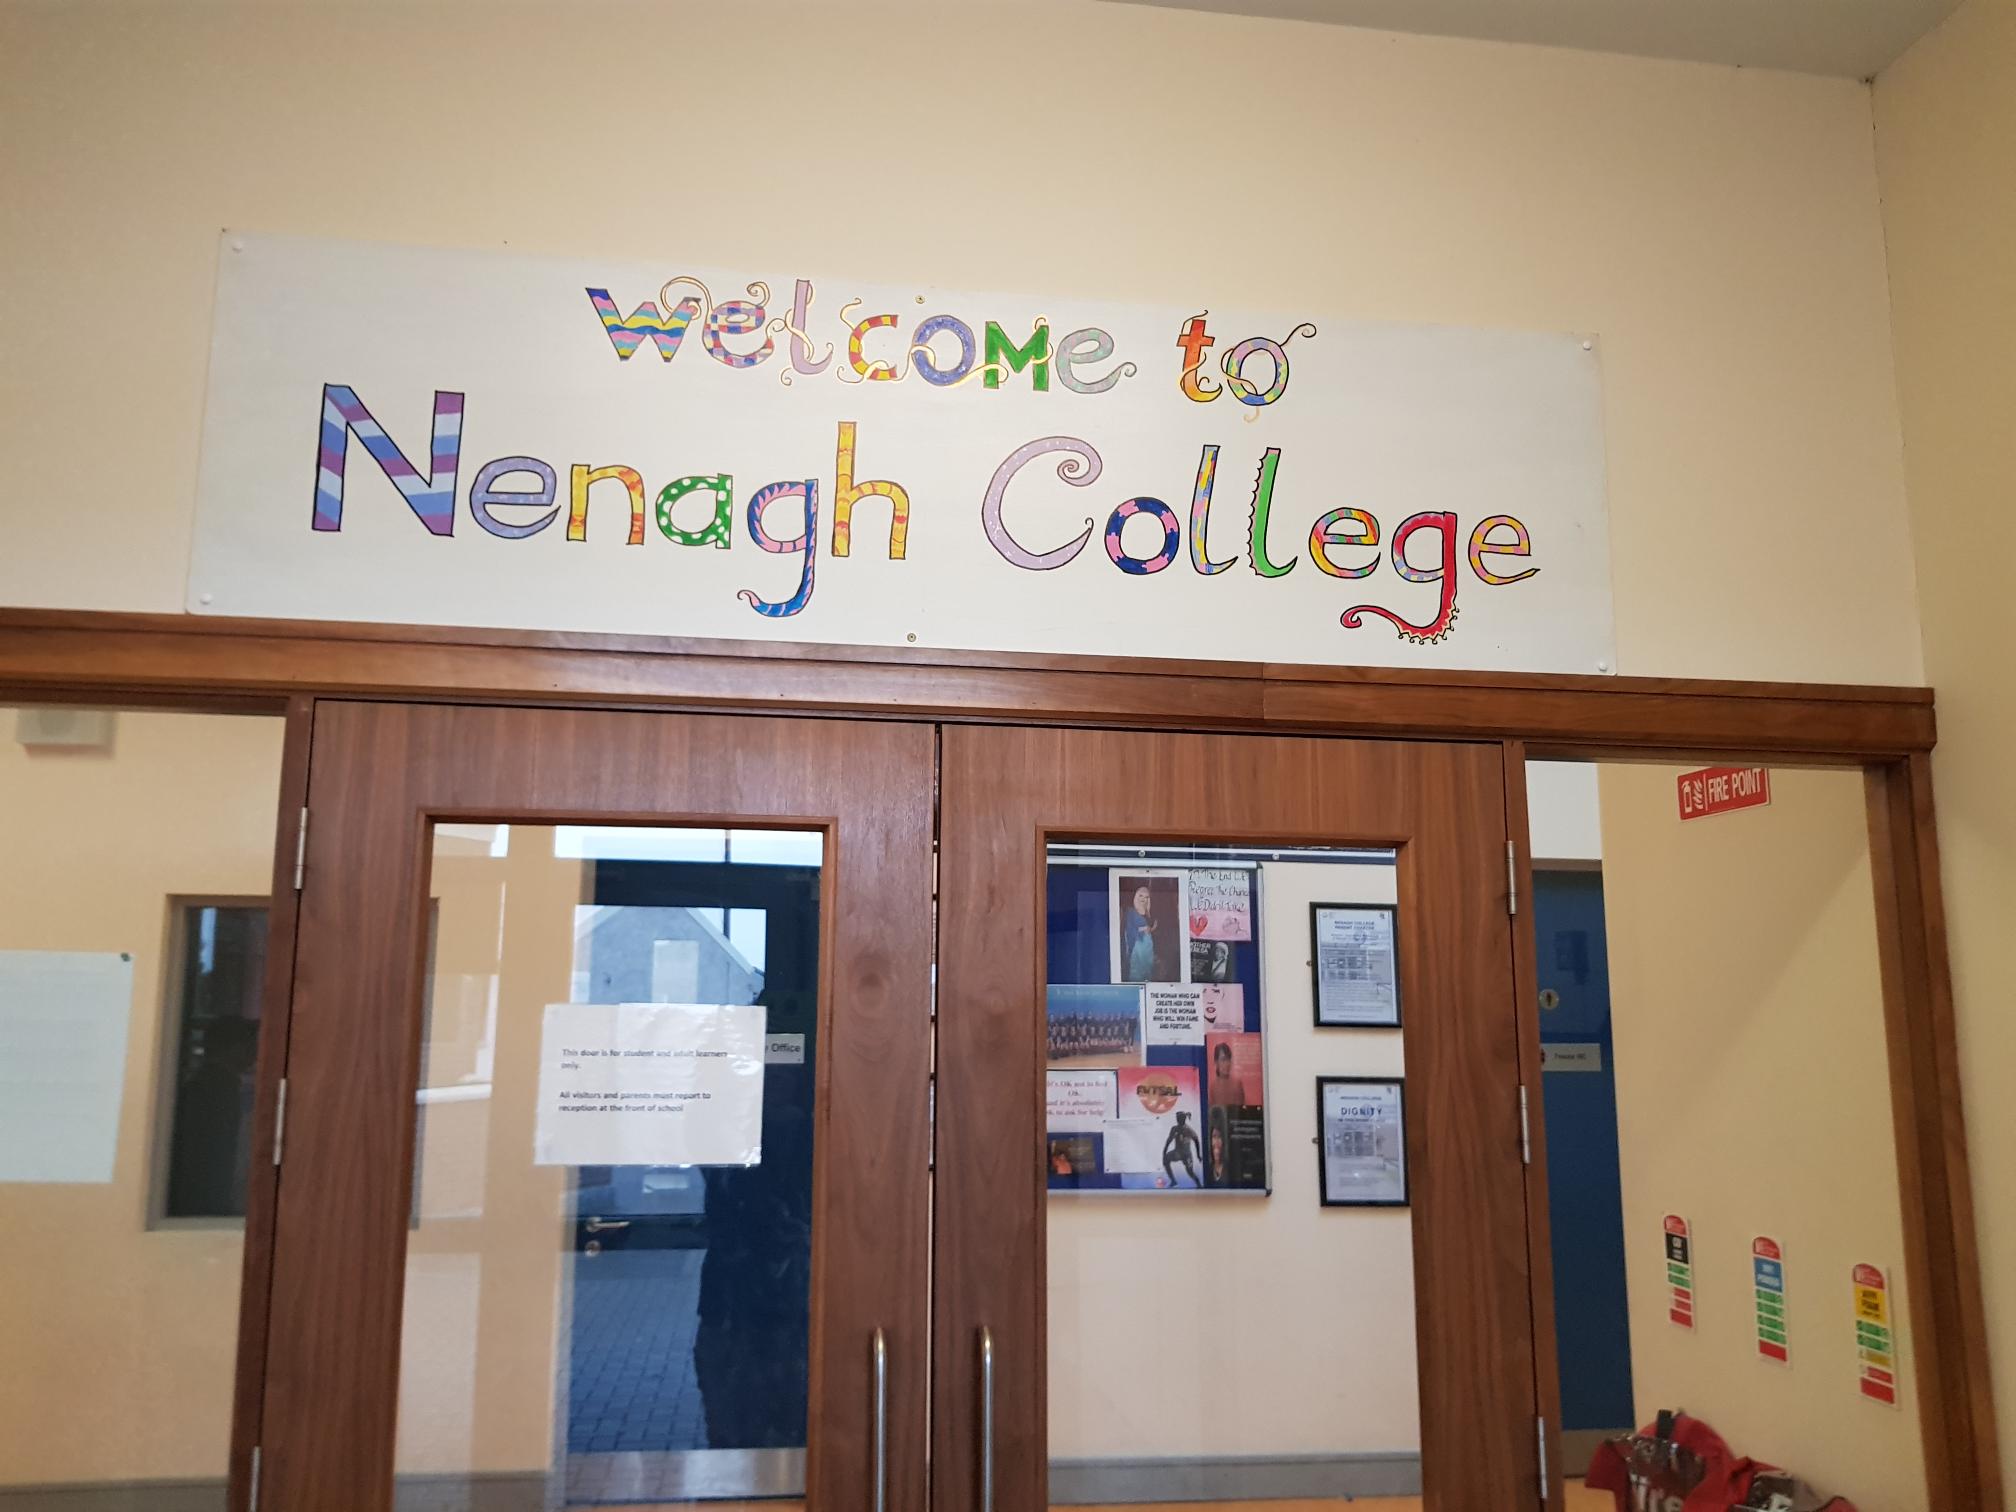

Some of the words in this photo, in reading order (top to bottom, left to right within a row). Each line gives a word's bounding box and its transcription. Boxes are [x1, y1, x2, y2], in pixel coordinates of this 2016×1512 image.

[1176, 309, 1317, 414] to
[312, 383, 910, 618] Nenagh
[981, 436, 1541, 645] College
[1708, 775, 1730, 803] FIRE
[1732, 768, 1762, 799] POINT
[771, 1043, 801, 1052] Office
[562, 1049, 578, 1057] This
[580, 1049, 599, 1057] door
[601, 1049, 608, 1057] is
[609, 1049, 620, 1057] for
[623, 1049, 654, 1057] student
[656, 1049, 671, 1057] and
[561, 1062, 581, 1070] only.
[1136, 1085, 1182, 1096] FUTSAL
[559, 1091, 570, 1099] All
[572, 1091, 600, 1099] visitors
[603, 1091, 618, 1099] and
[620, 1092, 651, 1101] parents
[675, 1092, 700, 1101] report
[559, 1104, 597, 1113] reception
[609, 1104, 623, 1112] the
[625, 1104, 645, 1112] front
[647, 1104, 656, 1112] of
[657, 1104, 684, 1112] school
[1341, 1106, 1382, 1116] DIGNITY
